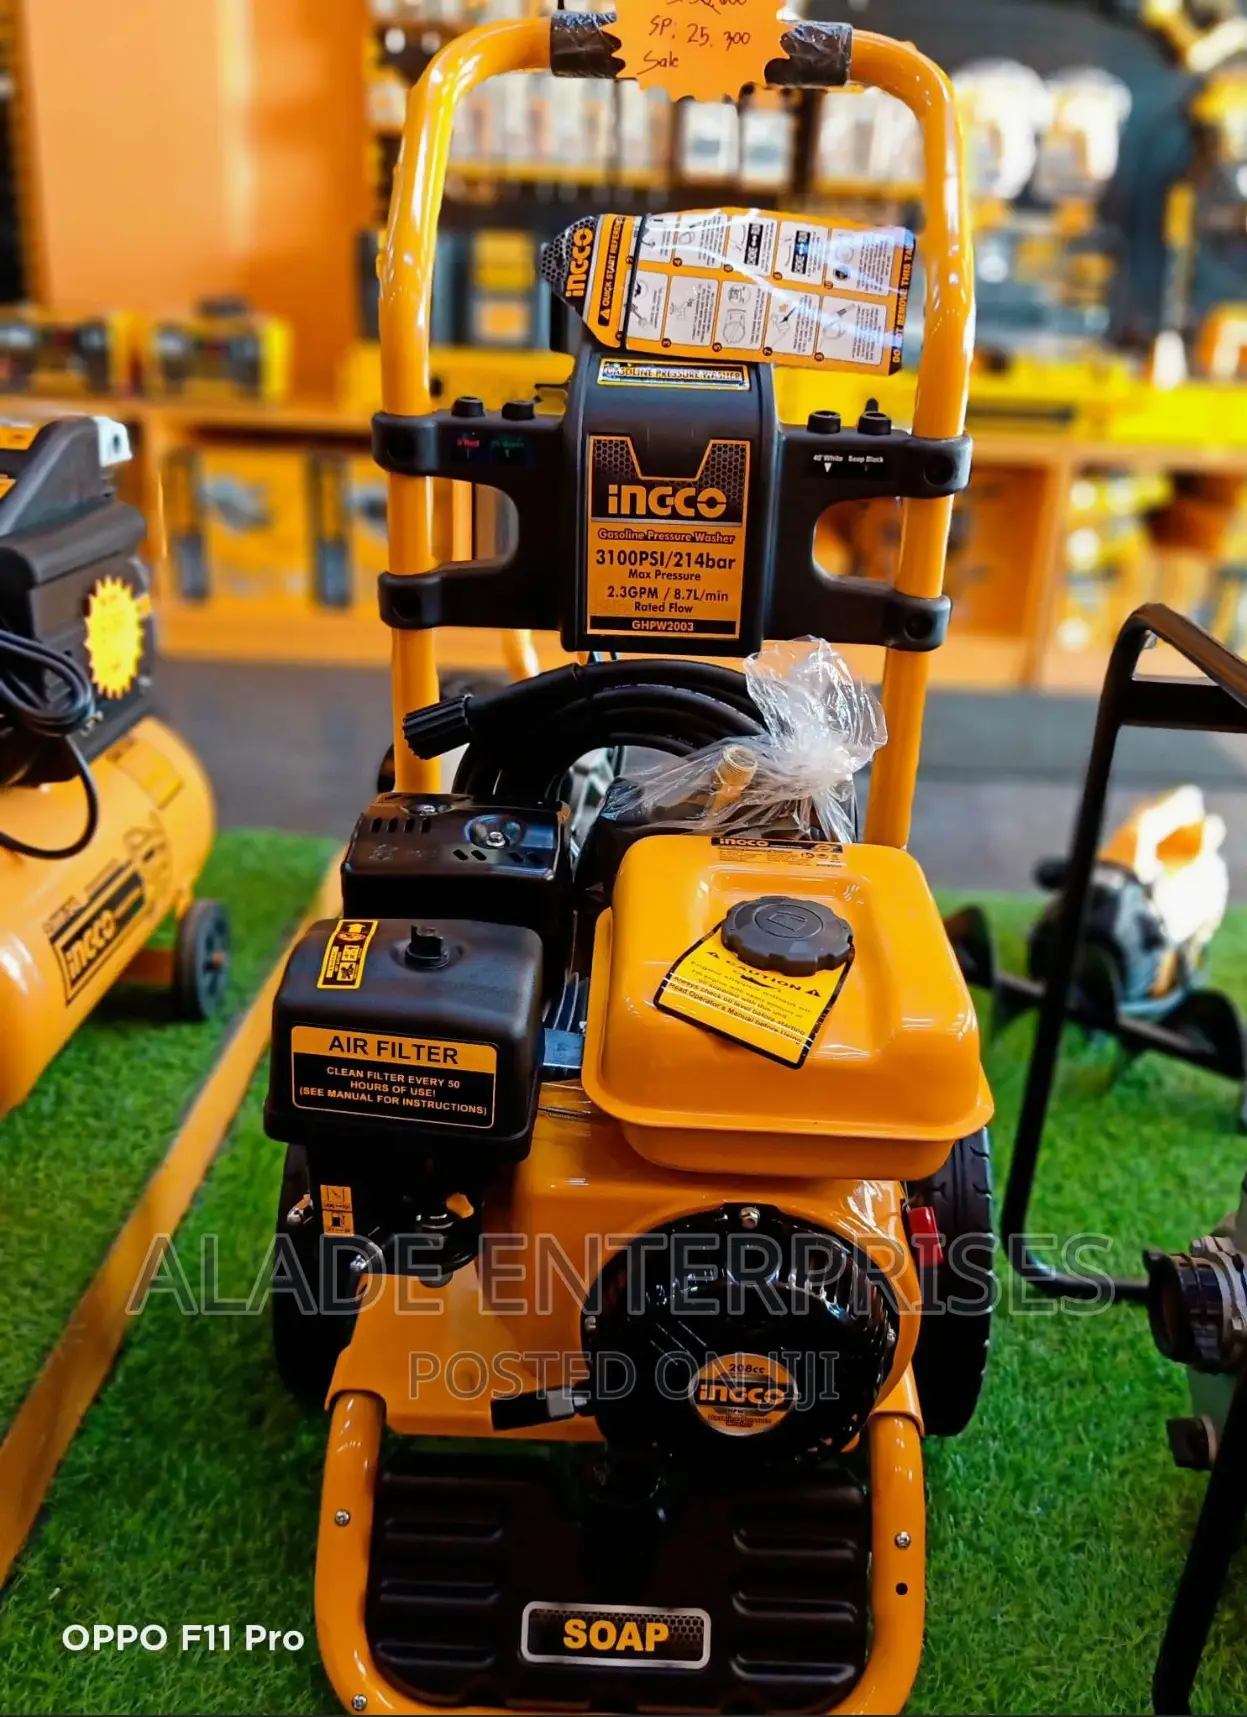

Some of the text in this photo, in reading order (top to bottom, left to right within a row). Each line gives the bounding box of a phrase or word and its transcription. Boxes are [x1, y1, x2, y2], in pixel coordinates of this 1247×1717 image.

[638, 50, 679, 75] Sale
[606, 255, 617, 278] START
[602, 279, 613, 307] QUICK
[892, 349, 901, 363] DO
[901, 264, 912, 285] THIS
[656, 369, 700, 379] PRESSURE
[701, 371, 743, 381] WASHER
[598, 529, 735, 544] Gasoline Pressure Washer
[596, 549, 736, 570] 3100PSI/214bar
[628, 569, 701, 581] Max Pressure
[607, 586, 658, 599] 2.3GPM
[674, 589, 729, 602] 8.7L/min
[634, 602, 693, 613] Rated Flow
[631, 620, 694, 632] GHPW2003
[725, 960, 802, 991] CAUTION
[668, 982, 688, 994] Read
[688, 990, 726, 1011] Operator's
[727, 1007, 755, 1023] Manual
[755, 1018, 779, 1032] before
[700, 987, 722, 999] check
[733, 1001, 752, 1012] level
[752, 1008, 775, 1021] before
[774, 1019, 806, 1036] starting
[328, 1035, 459, 1065] AIR FILTER
[326, 1066, 460, 1089] CLEAN FILTER EVERY 50
[350, 1080, 436, 1098] HOURS OF USE!
[300, 1086, 488, 1116] (SEE MANUAL FOR INSTRUCTIONS)
[729, 1363, 766, 1374] 208cc
[563, 1618, 669, 1652] SOAP
